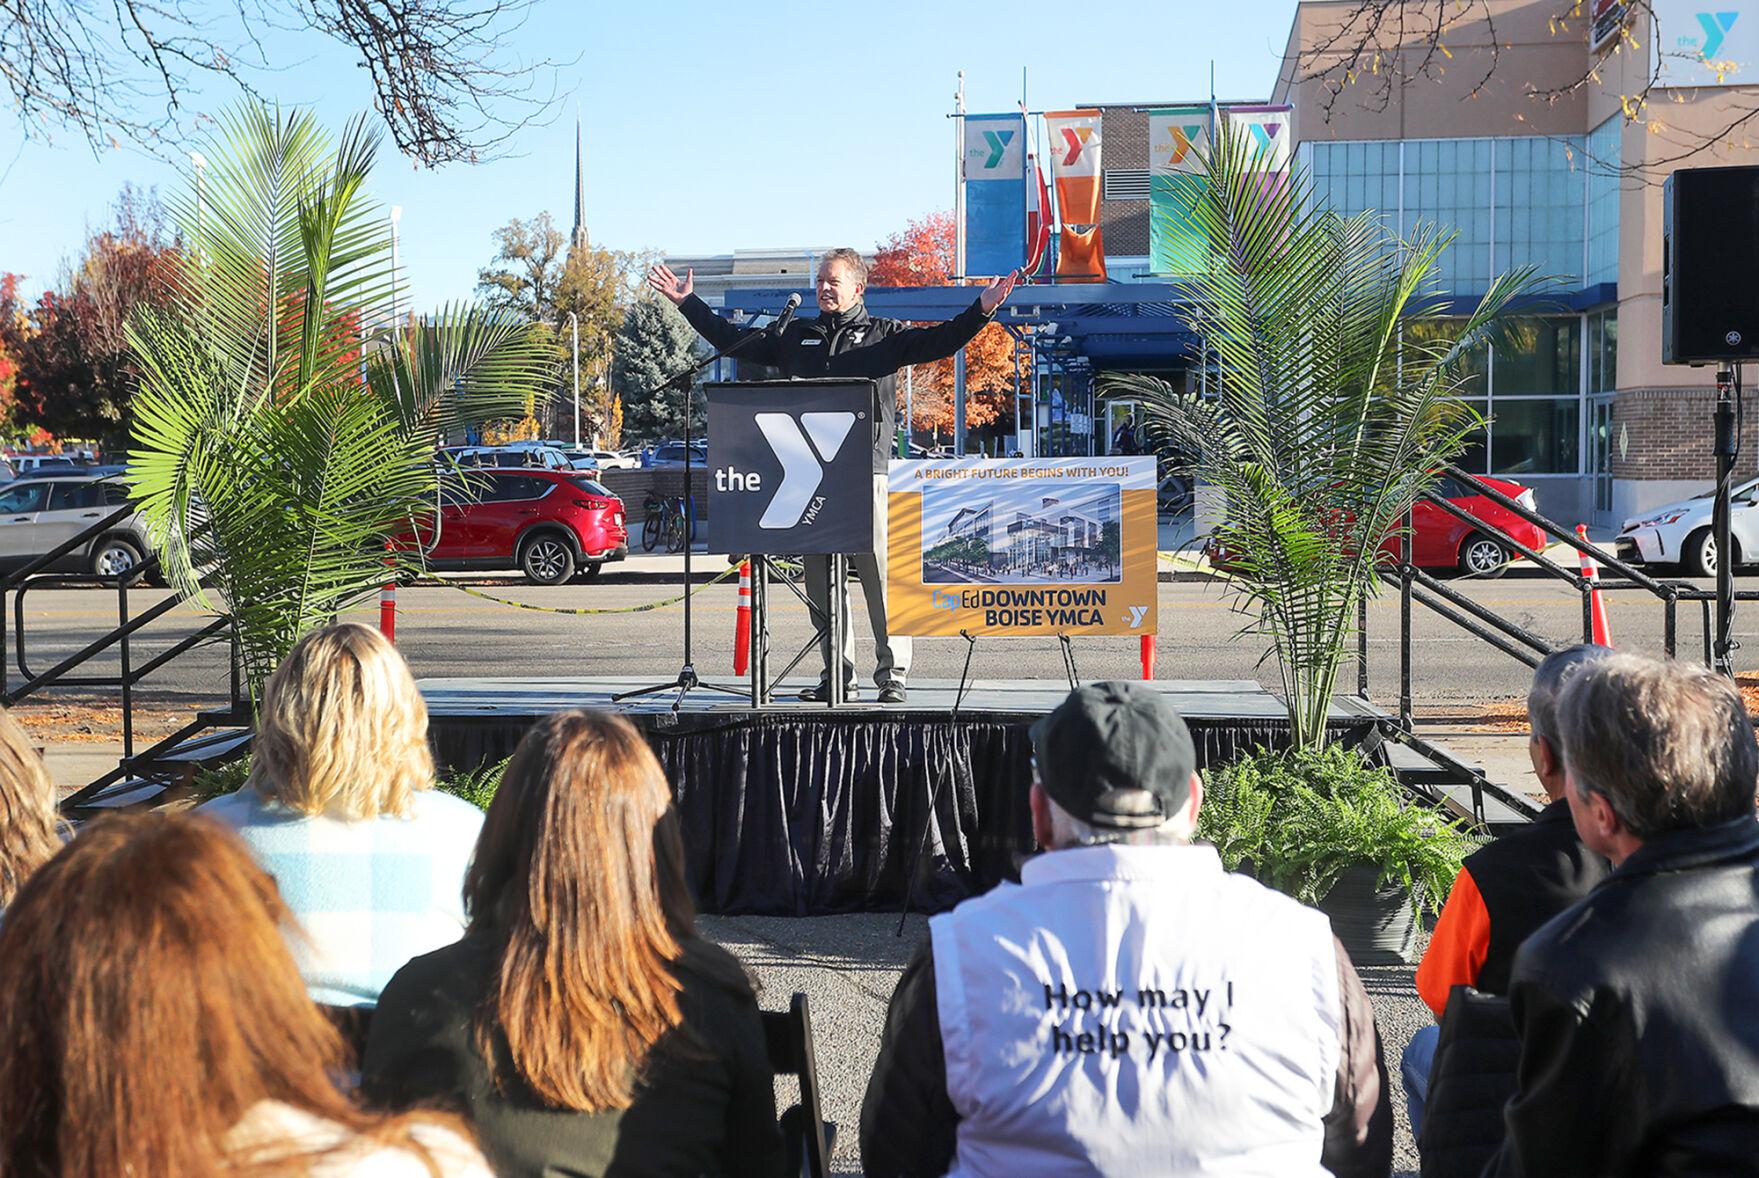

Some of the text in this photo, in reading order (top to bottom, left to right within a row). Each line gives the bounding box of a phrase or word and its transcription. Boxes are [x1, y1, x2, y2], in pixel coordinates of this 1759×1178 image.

[715, 465, 761, 492] the
[914, 466, 1129, 479] A BRIGHT FUTURE BEGINS WITH YOU!
[801, 495, 827, 527] YMCA
[982, 589, 1107, 607] DOWNTOWN
[985, 609, 1043, 627] BOISE
[1045, 609, 1104, 626] YMCA
[1043, 981, 1234, 1017] How may I
[1053, 1023, 1232, 1060] help you?
